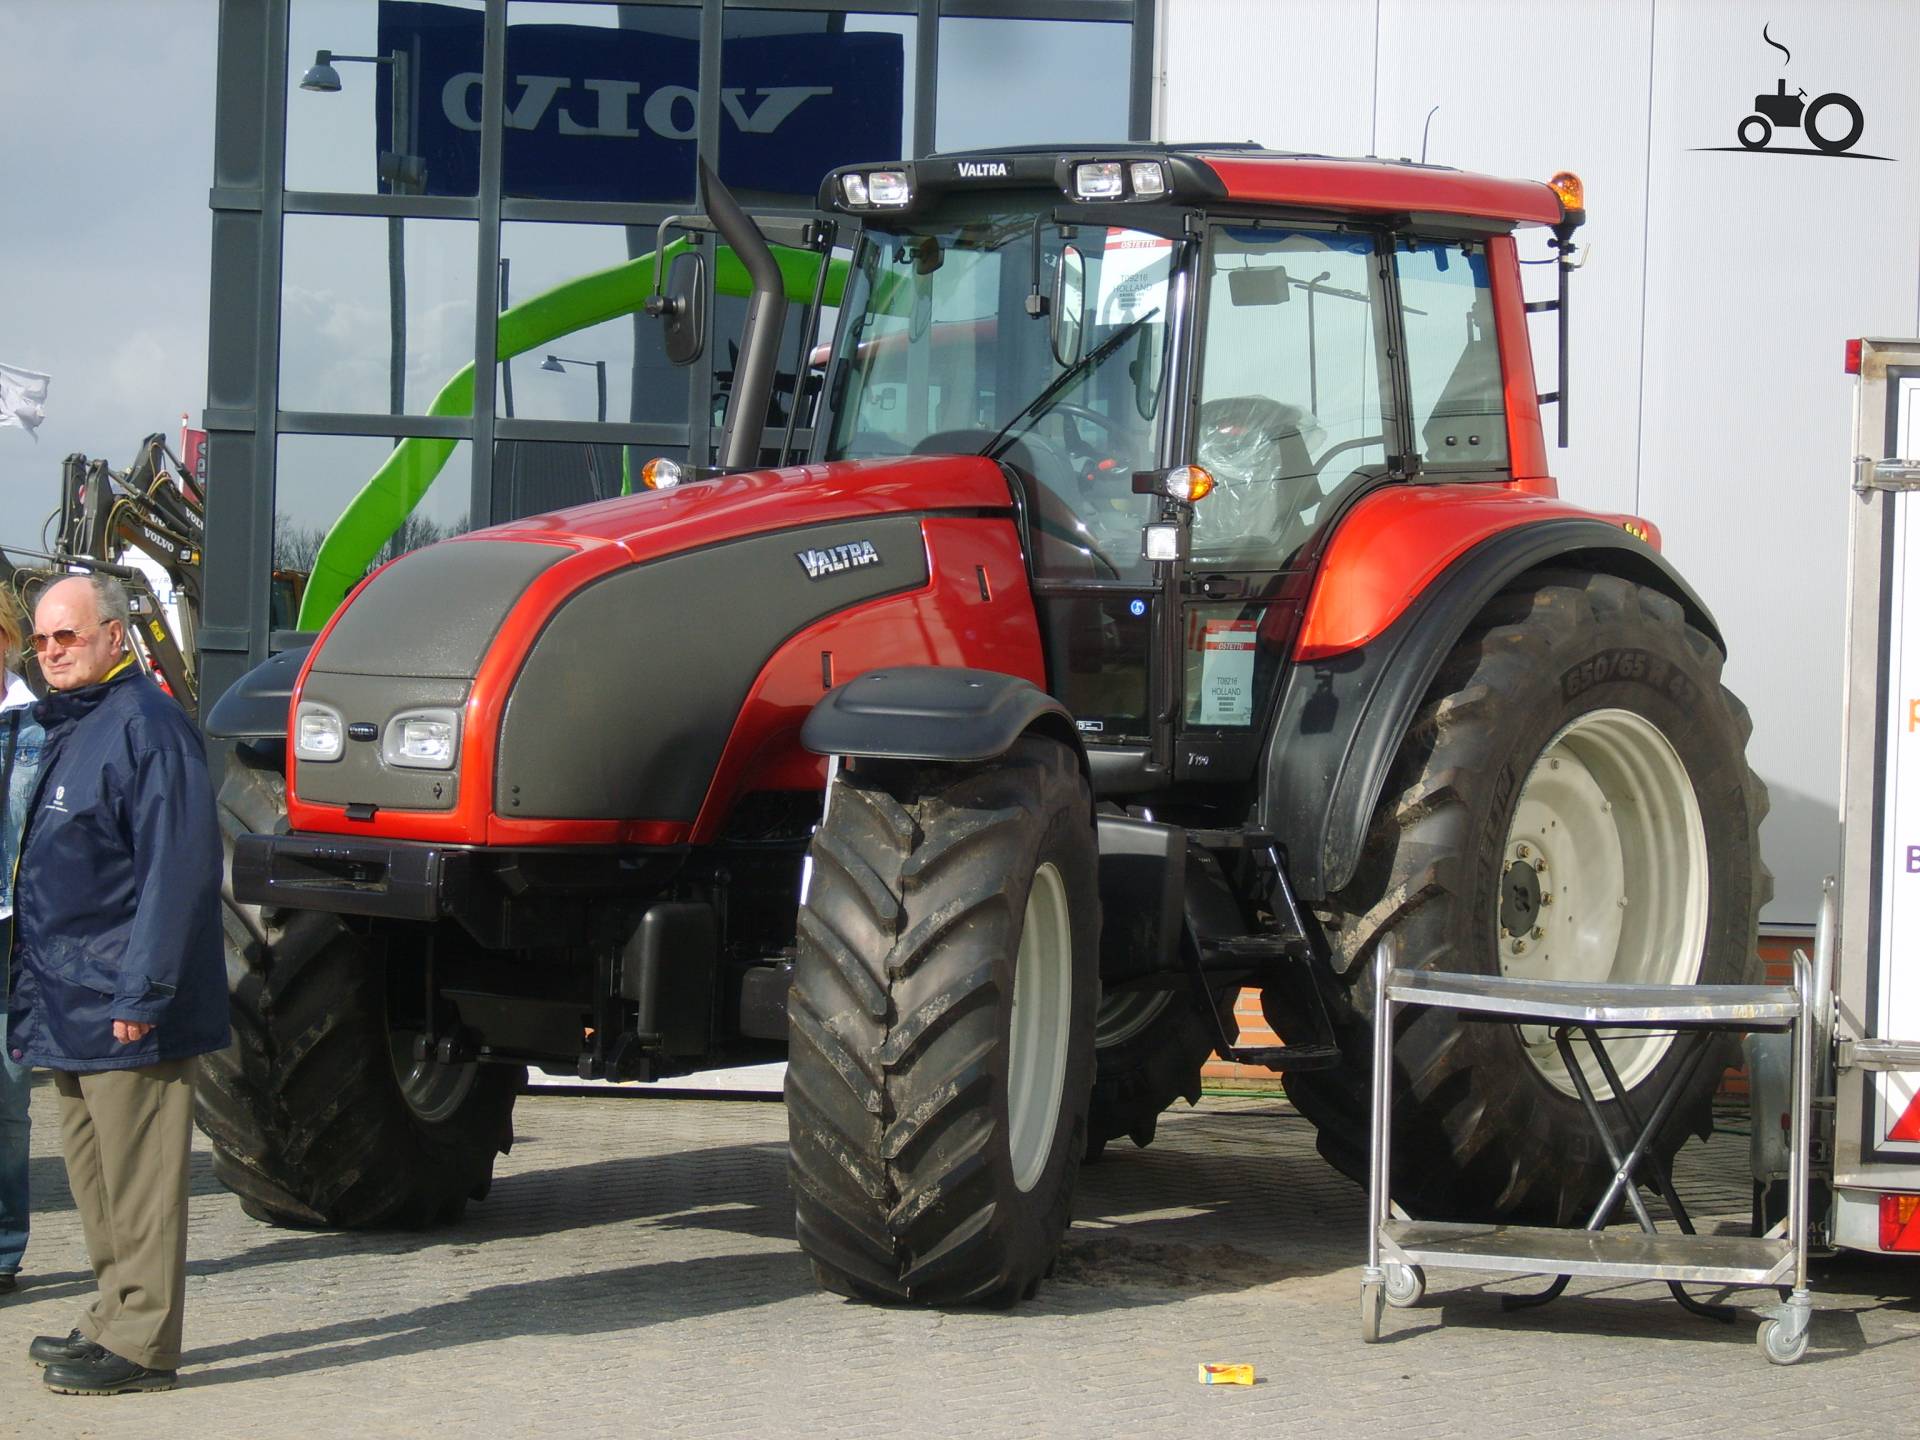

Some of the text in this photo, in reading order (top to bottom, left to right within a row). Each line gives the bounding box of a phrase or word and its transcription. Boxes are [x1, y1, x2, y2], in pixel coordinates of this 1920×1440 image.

[958, 162, 1007, 177] VALTRA
[143, 526, 174, 553] VOLVO
[797, 540, 879, 578] VALTRA
[1211, 687, 1241, 697] HOLLAND
